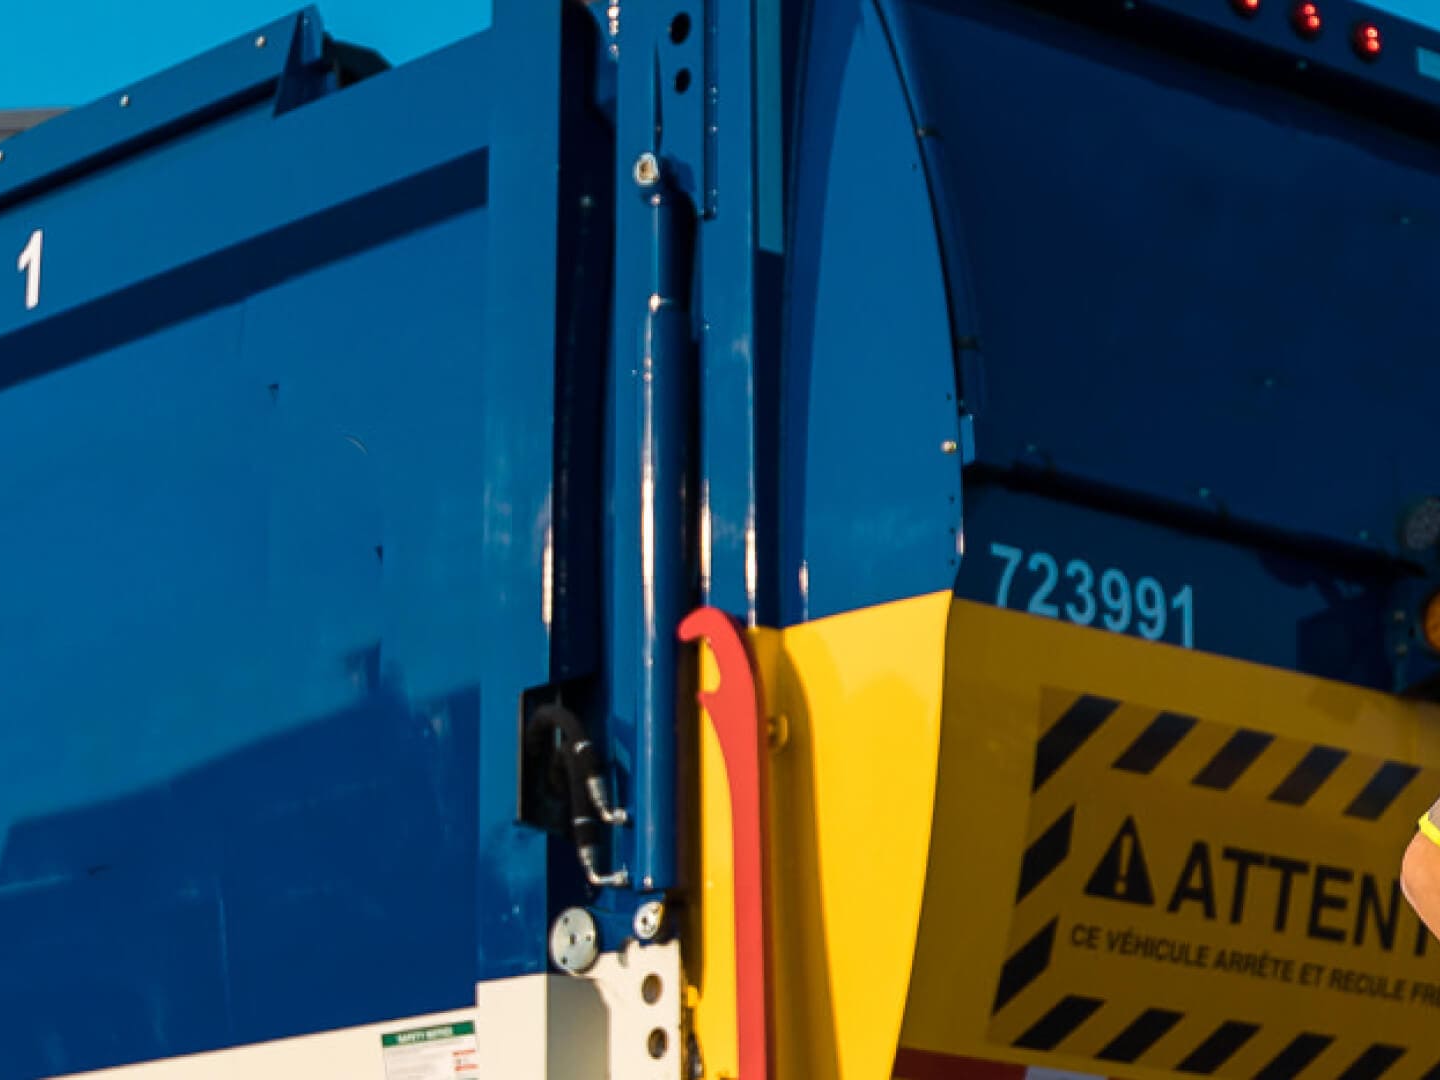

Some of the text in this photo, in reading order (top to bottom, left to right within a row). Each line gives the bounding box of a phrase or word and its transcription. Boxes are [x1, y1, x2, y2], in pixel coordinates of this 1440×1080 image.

[991, 542, 1194, 649] 723991
[1071, 922, 1099, 951] CE
[1108, 925, 1209, 967] VÉHICULE
[1299, 962, 1326, 987] ET
[1329, 967, 1407, 1003] RECULE
